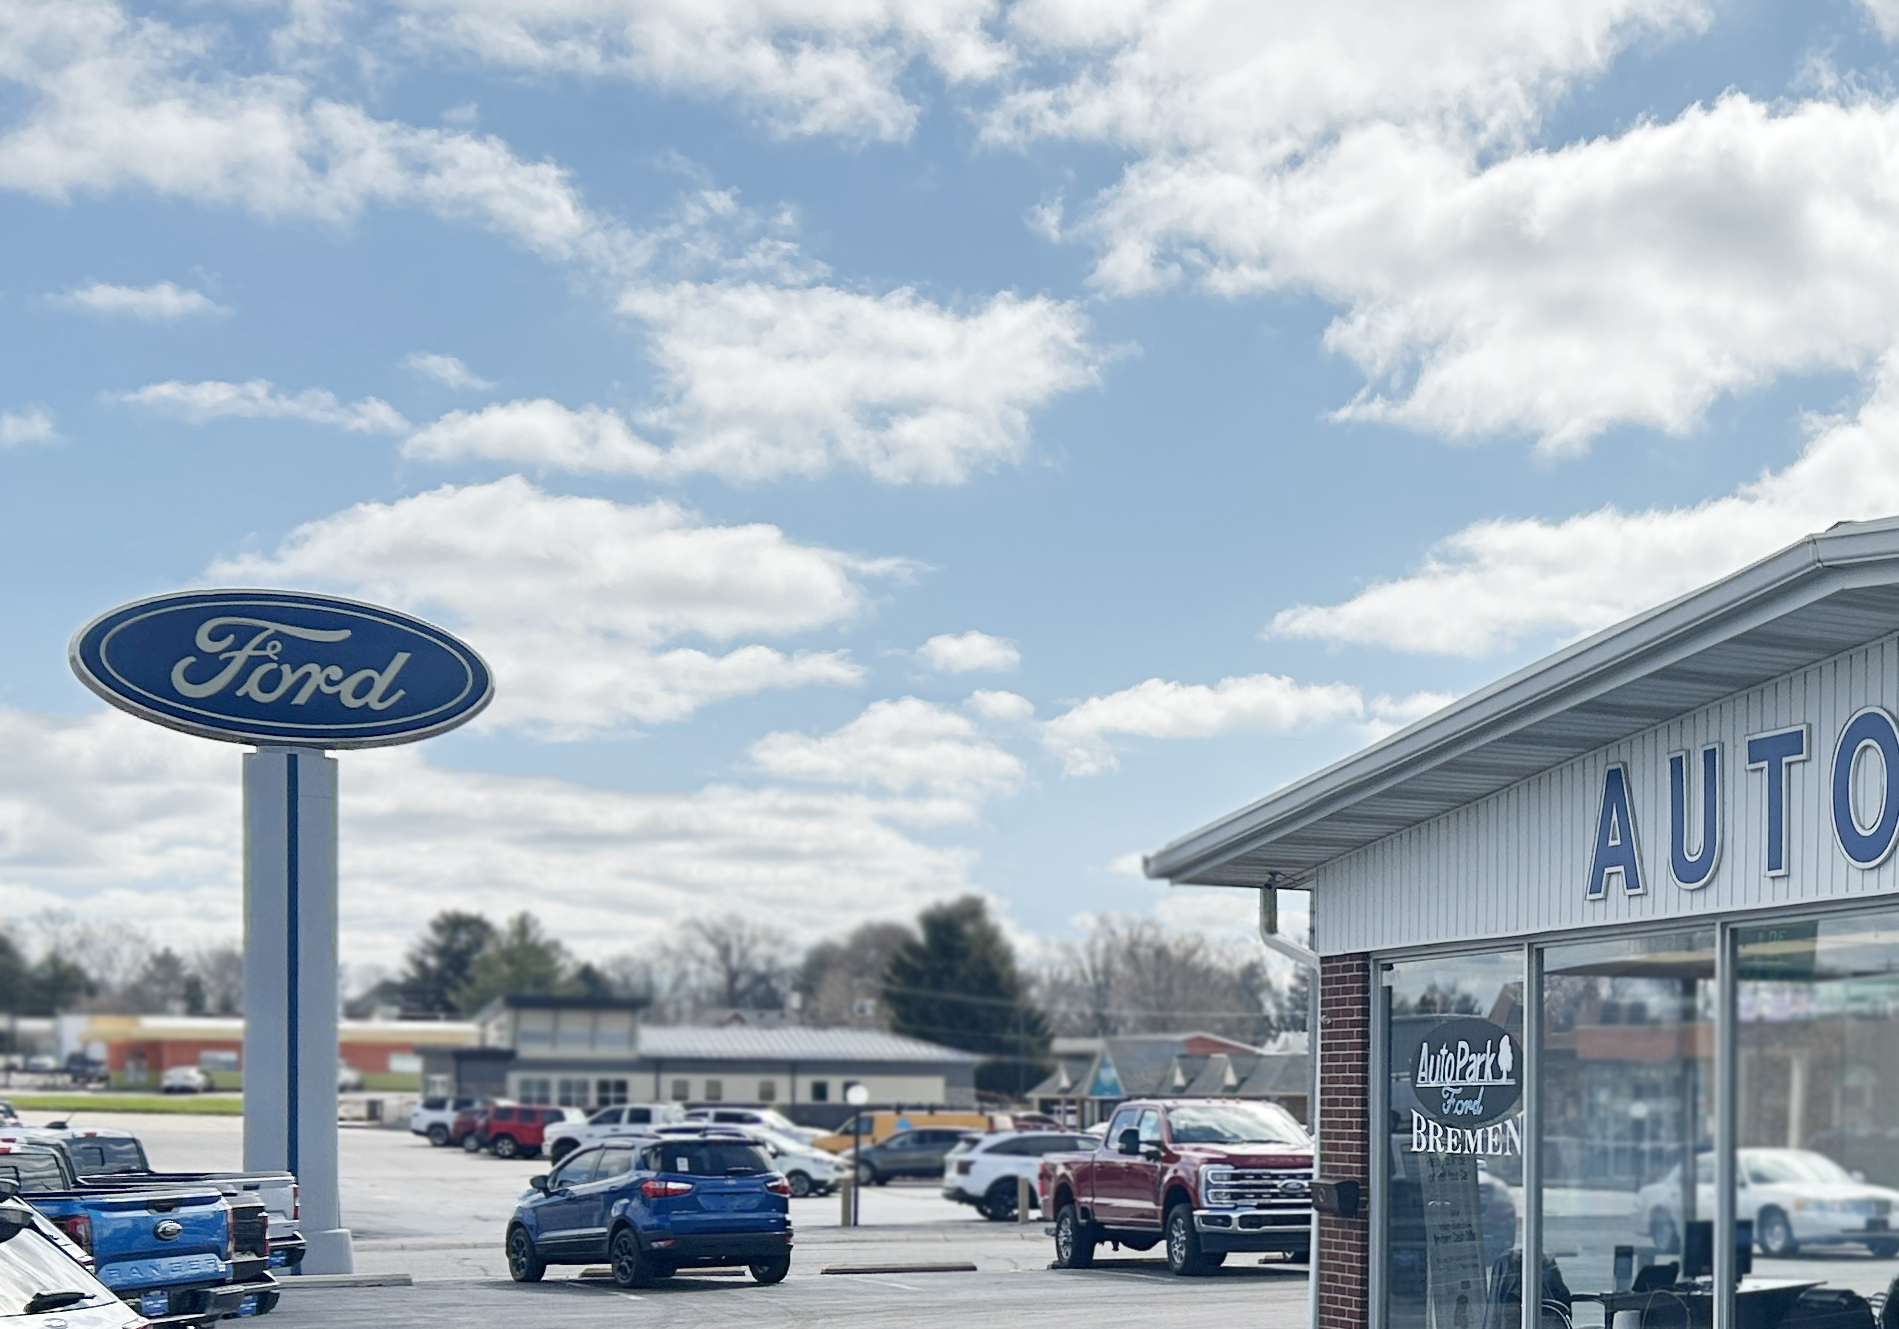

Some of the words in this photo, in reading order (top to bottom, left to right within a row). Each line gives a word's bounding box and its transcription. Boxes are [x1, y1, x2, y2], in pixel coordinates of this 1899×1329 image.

[170, 616, 411, 711] Ford
[1442, 1086, 1485, 1116] Ford
[1410, 1108, 1525, 1156] BREMEN
